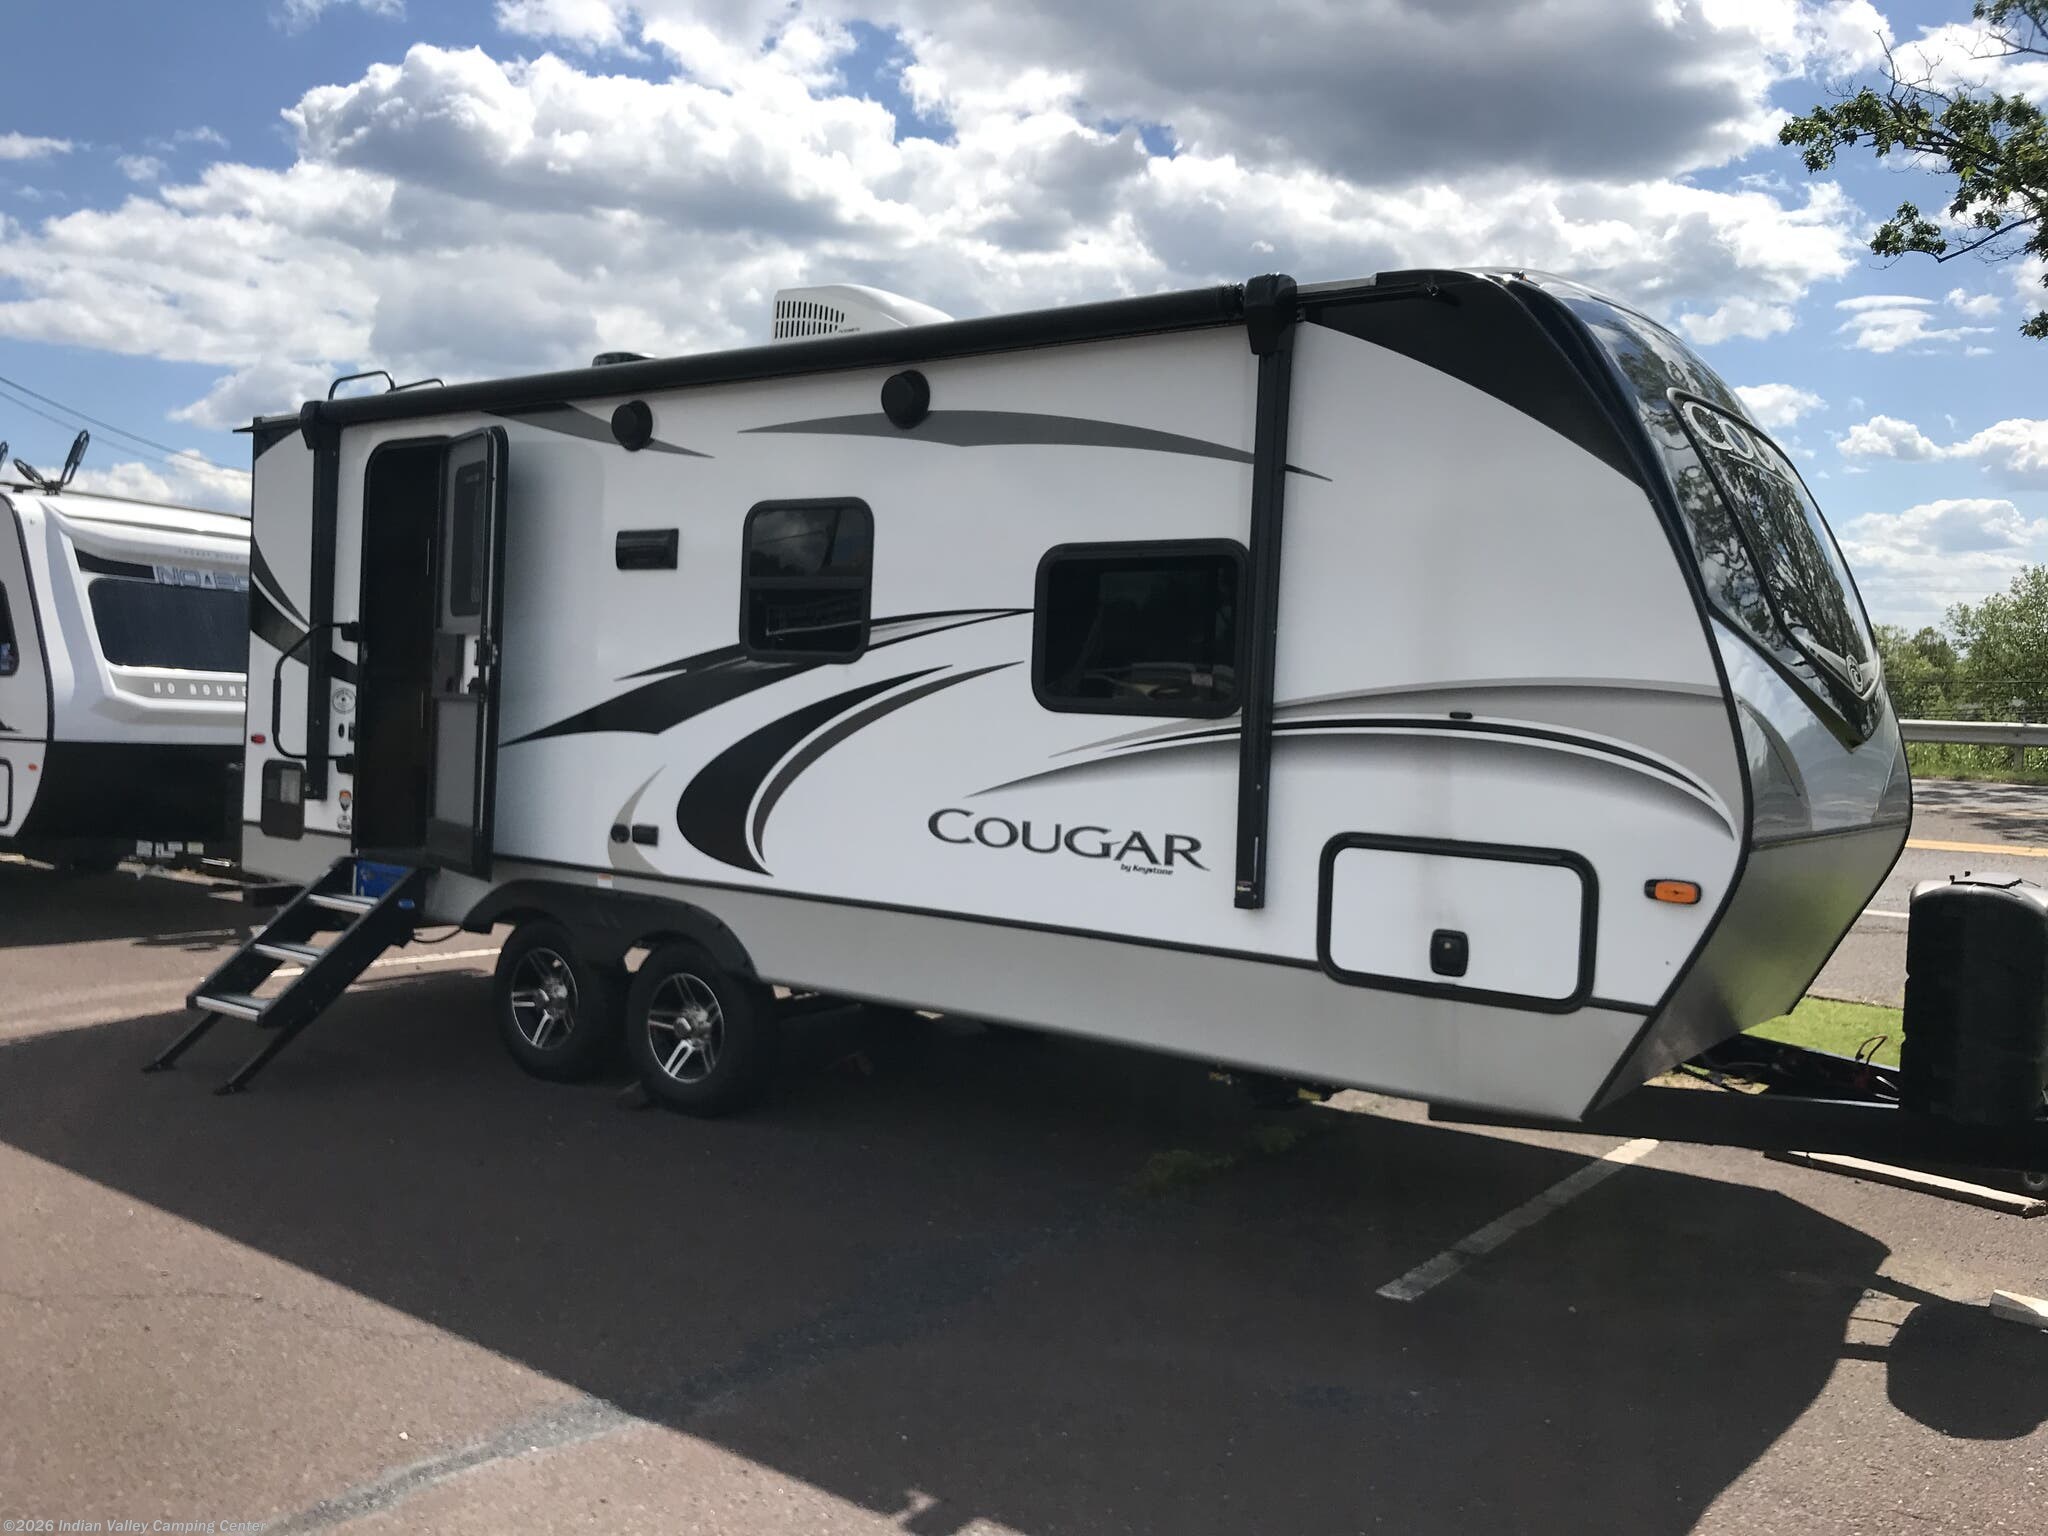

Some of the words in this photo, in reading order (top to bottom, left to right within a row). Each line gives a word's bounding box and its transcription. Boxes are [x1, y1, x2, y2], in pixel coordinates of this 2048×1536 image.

[153, 682, 176, 694] NO
[928, 808, 1211, 872] COUGAR
[1121, 863, 1131, 873] by
[1132, 864, 1174, 876] Keystone
